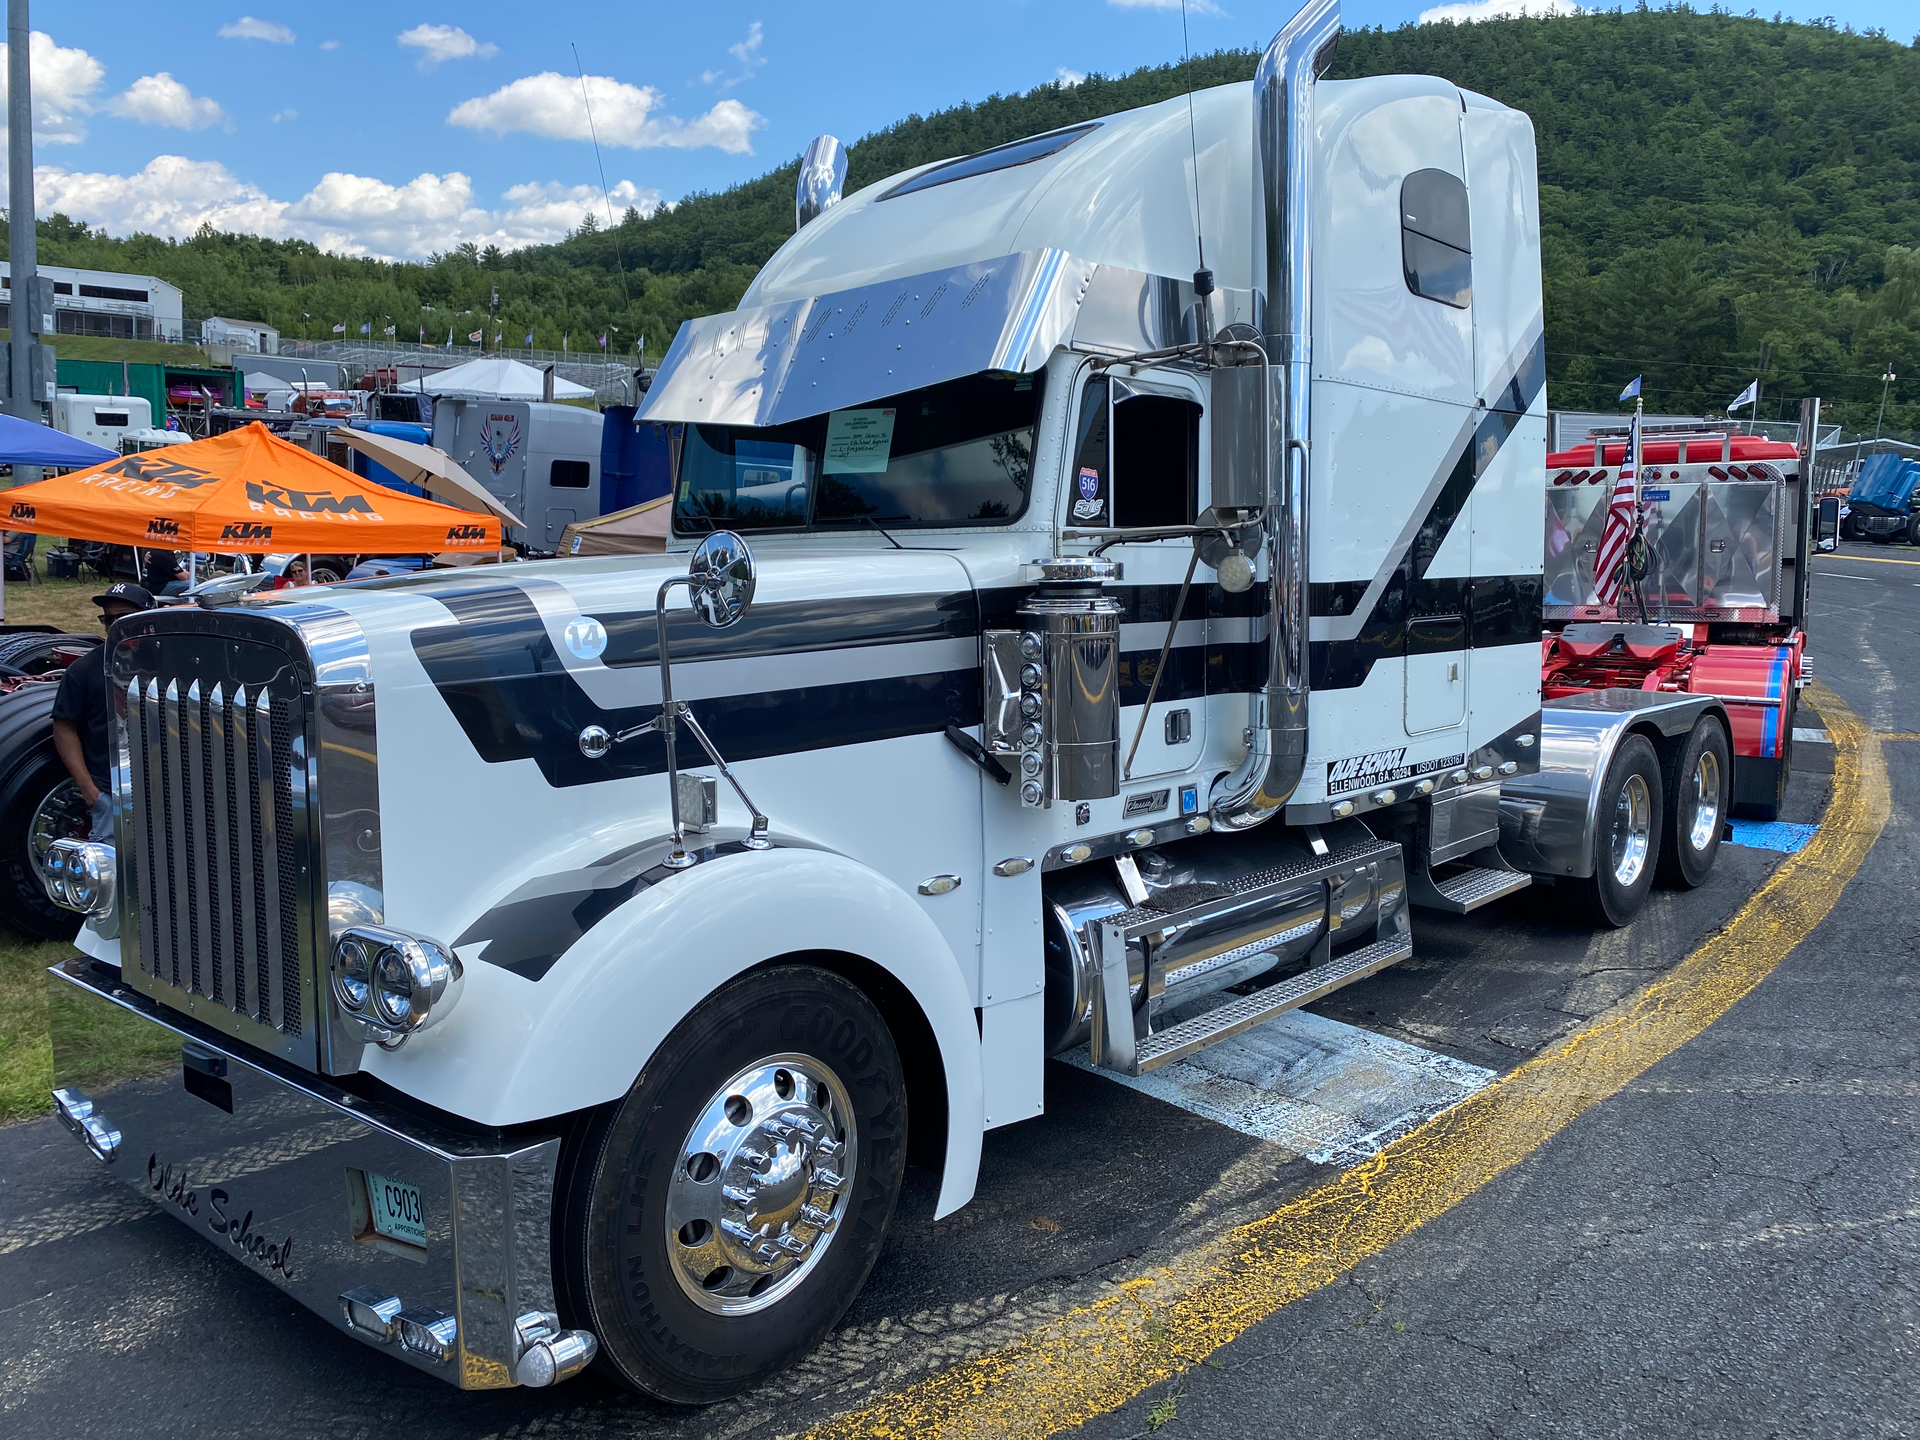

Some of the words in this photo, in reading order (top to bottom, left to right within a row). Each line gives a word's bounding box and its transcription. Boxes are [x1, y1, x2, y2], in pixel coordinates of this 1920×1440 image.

[102, 456, 220, 489] KTM
[1082, 477, 1096, 492] 516
[9, 502, 36, 519] KTM
[245, 480, 375, 514] KTM
[147, 517, 179, 535] KTM
[220, 522, 274, 539] KTM
[446, 525, 486, 539] KTM
[568, 624, 603, 650] 14
[1328, 757, 1363, 783] OLDE
[1359, 748, 1406, 776] SCHOOL
[1416, 761, 1438, 774] USDOT
[780, 1004, 895, 1260] GOODYEAR
[627, 1148, 657, 1236] LHS
[148, 1152, 198, 1217] Olde
[208, 1188, 293, 1279] School
[627, 1253, 747, 1372] MARATHON
